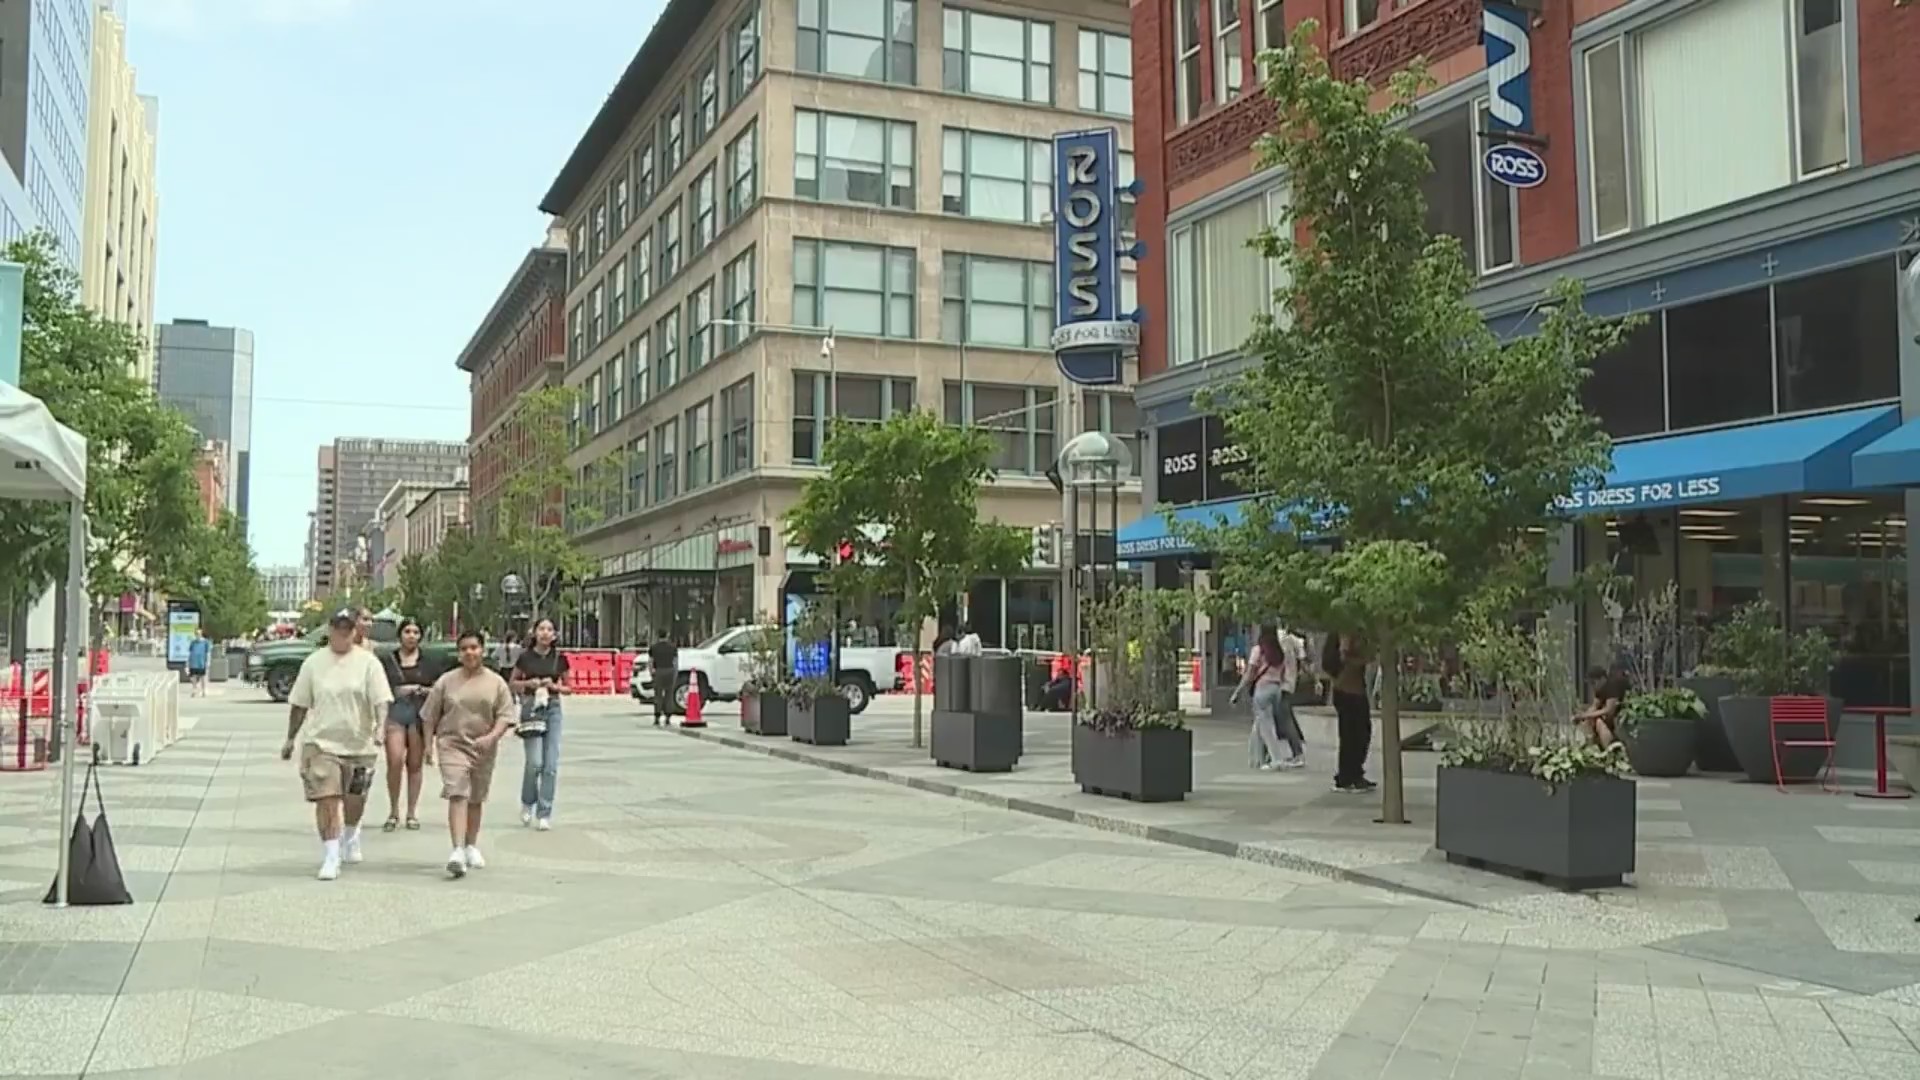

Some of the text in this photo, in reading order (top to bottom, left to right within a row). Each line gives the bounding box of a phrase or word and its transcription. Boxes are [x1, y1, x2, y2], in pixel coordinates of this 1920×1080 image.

[1490, 152, 1539, 179] ROSS
[1064, 145, 1102, 317] ROSS
[1164, 453, 1197, 475] ROSS
[1588, 487, 1636, 506] DRESS
[1641, 482, 1672, 502] FOR
[1678, 476, 1721, 498] LESS
[1160, 536, 1176, 550] FOR
